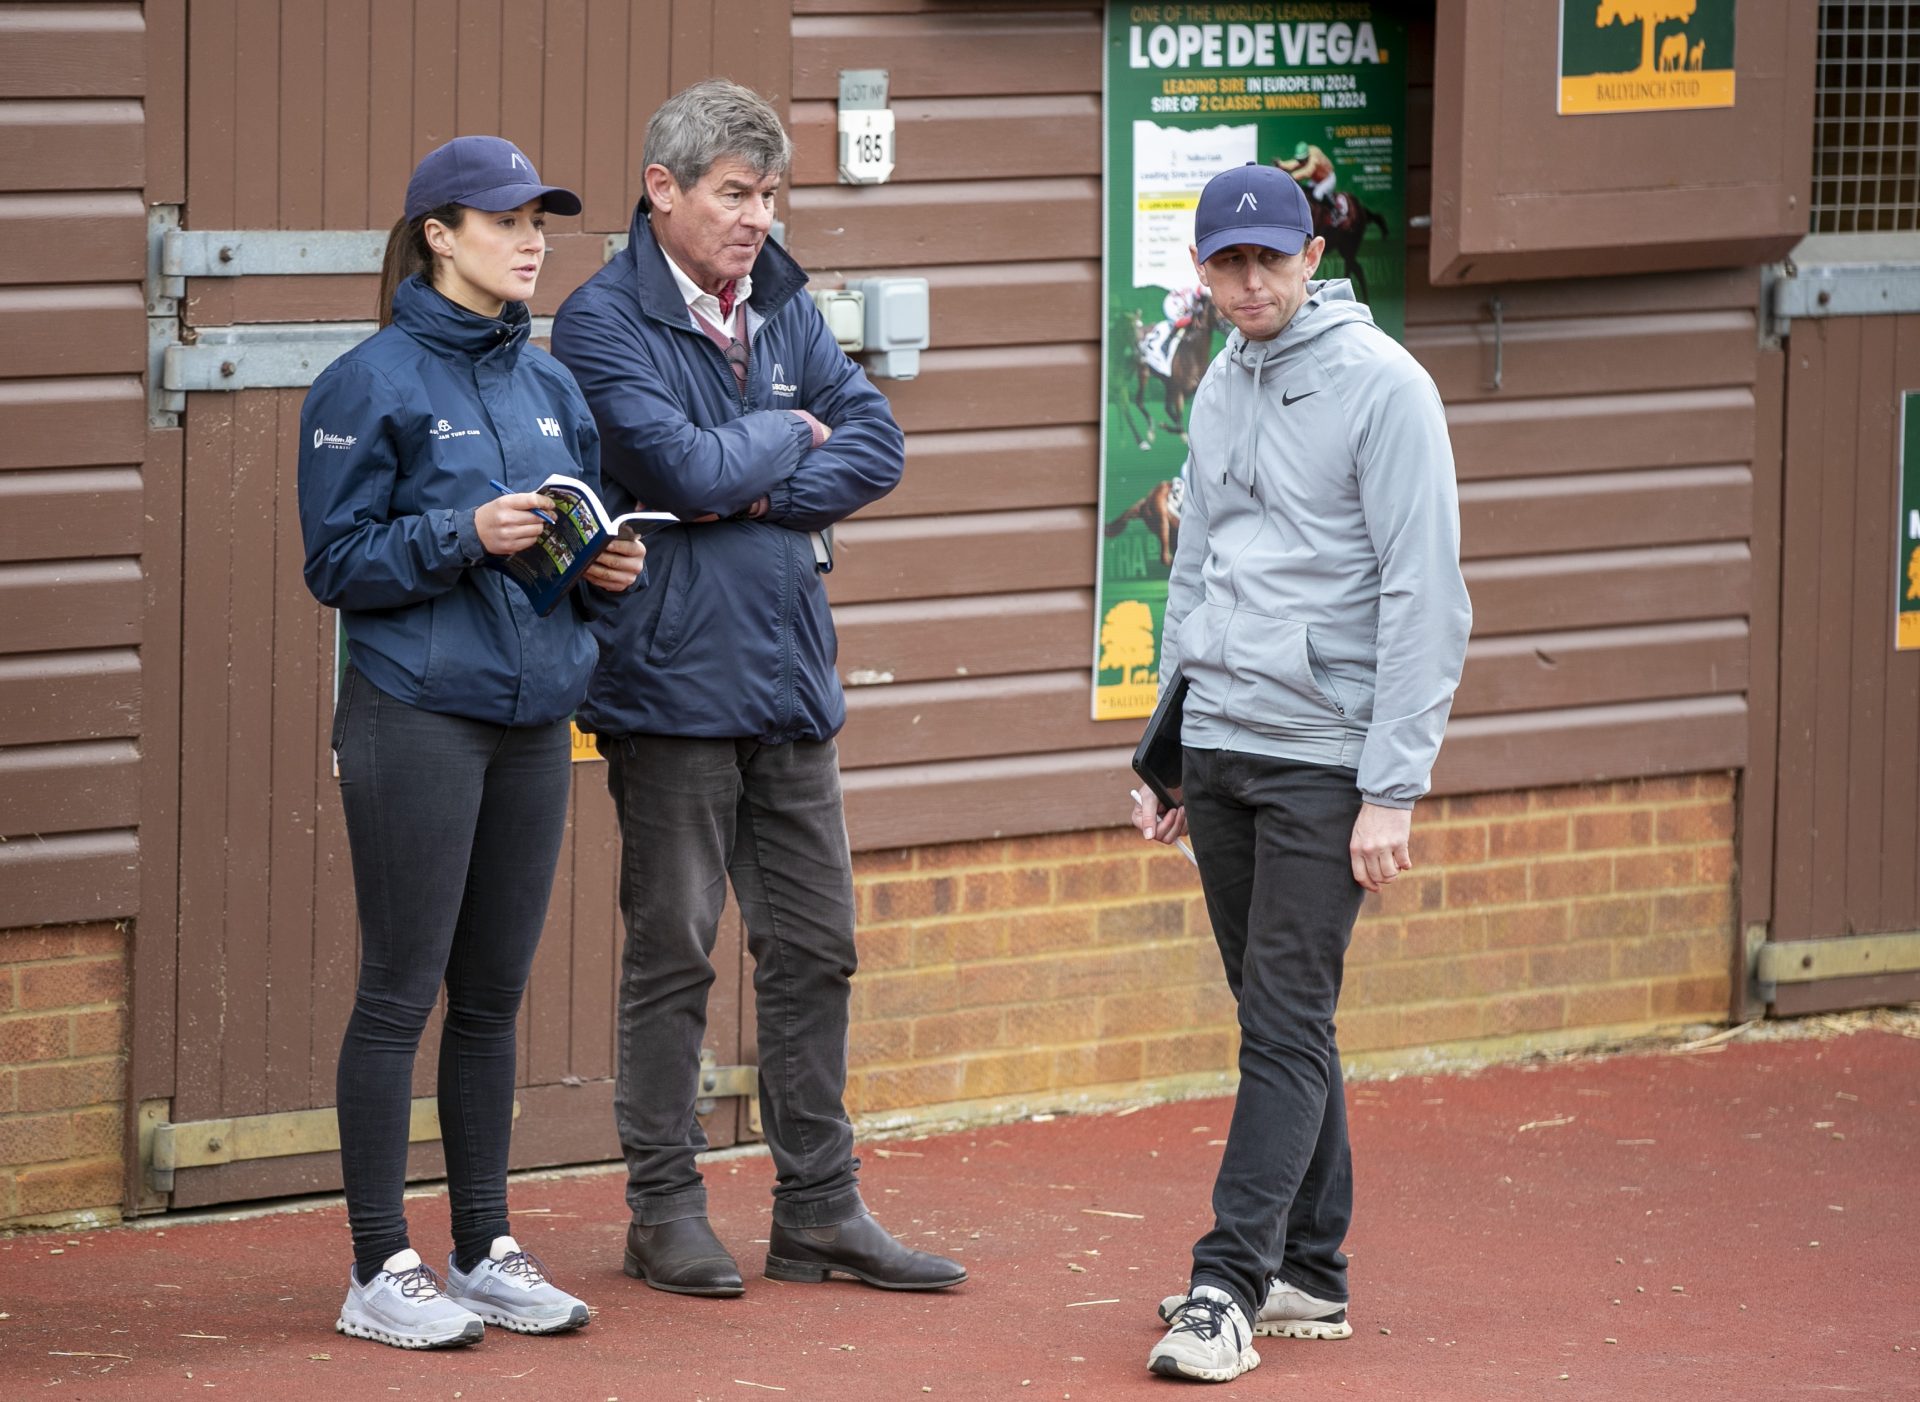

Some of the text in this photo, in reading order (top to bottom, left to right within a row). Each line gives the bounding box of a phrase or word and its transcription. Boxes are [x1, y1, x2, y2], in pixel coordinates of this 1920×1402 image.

[1130, 3, 1371, 22] ONE OF THE WORLD'S LEADING SIRES
[1130, 24, 1223, 68] LOPE
[1228, 23, 1275, 67] DE
[845, 84, 868, 101] LOT
[1162, 75, 1356, 95] LEADING SIRE IN EUROPE IN 2024
[1596, 79, 1700, 100] BALLYLINCH STUD
[1151, 92, 1367, 112] SIRE OF 2 CLASSIC WINNERS IN 2024
[856, 134, 882, 163] 185
[451, 430, 466, 438] TURF
[536, 417, 562, 437] HH
